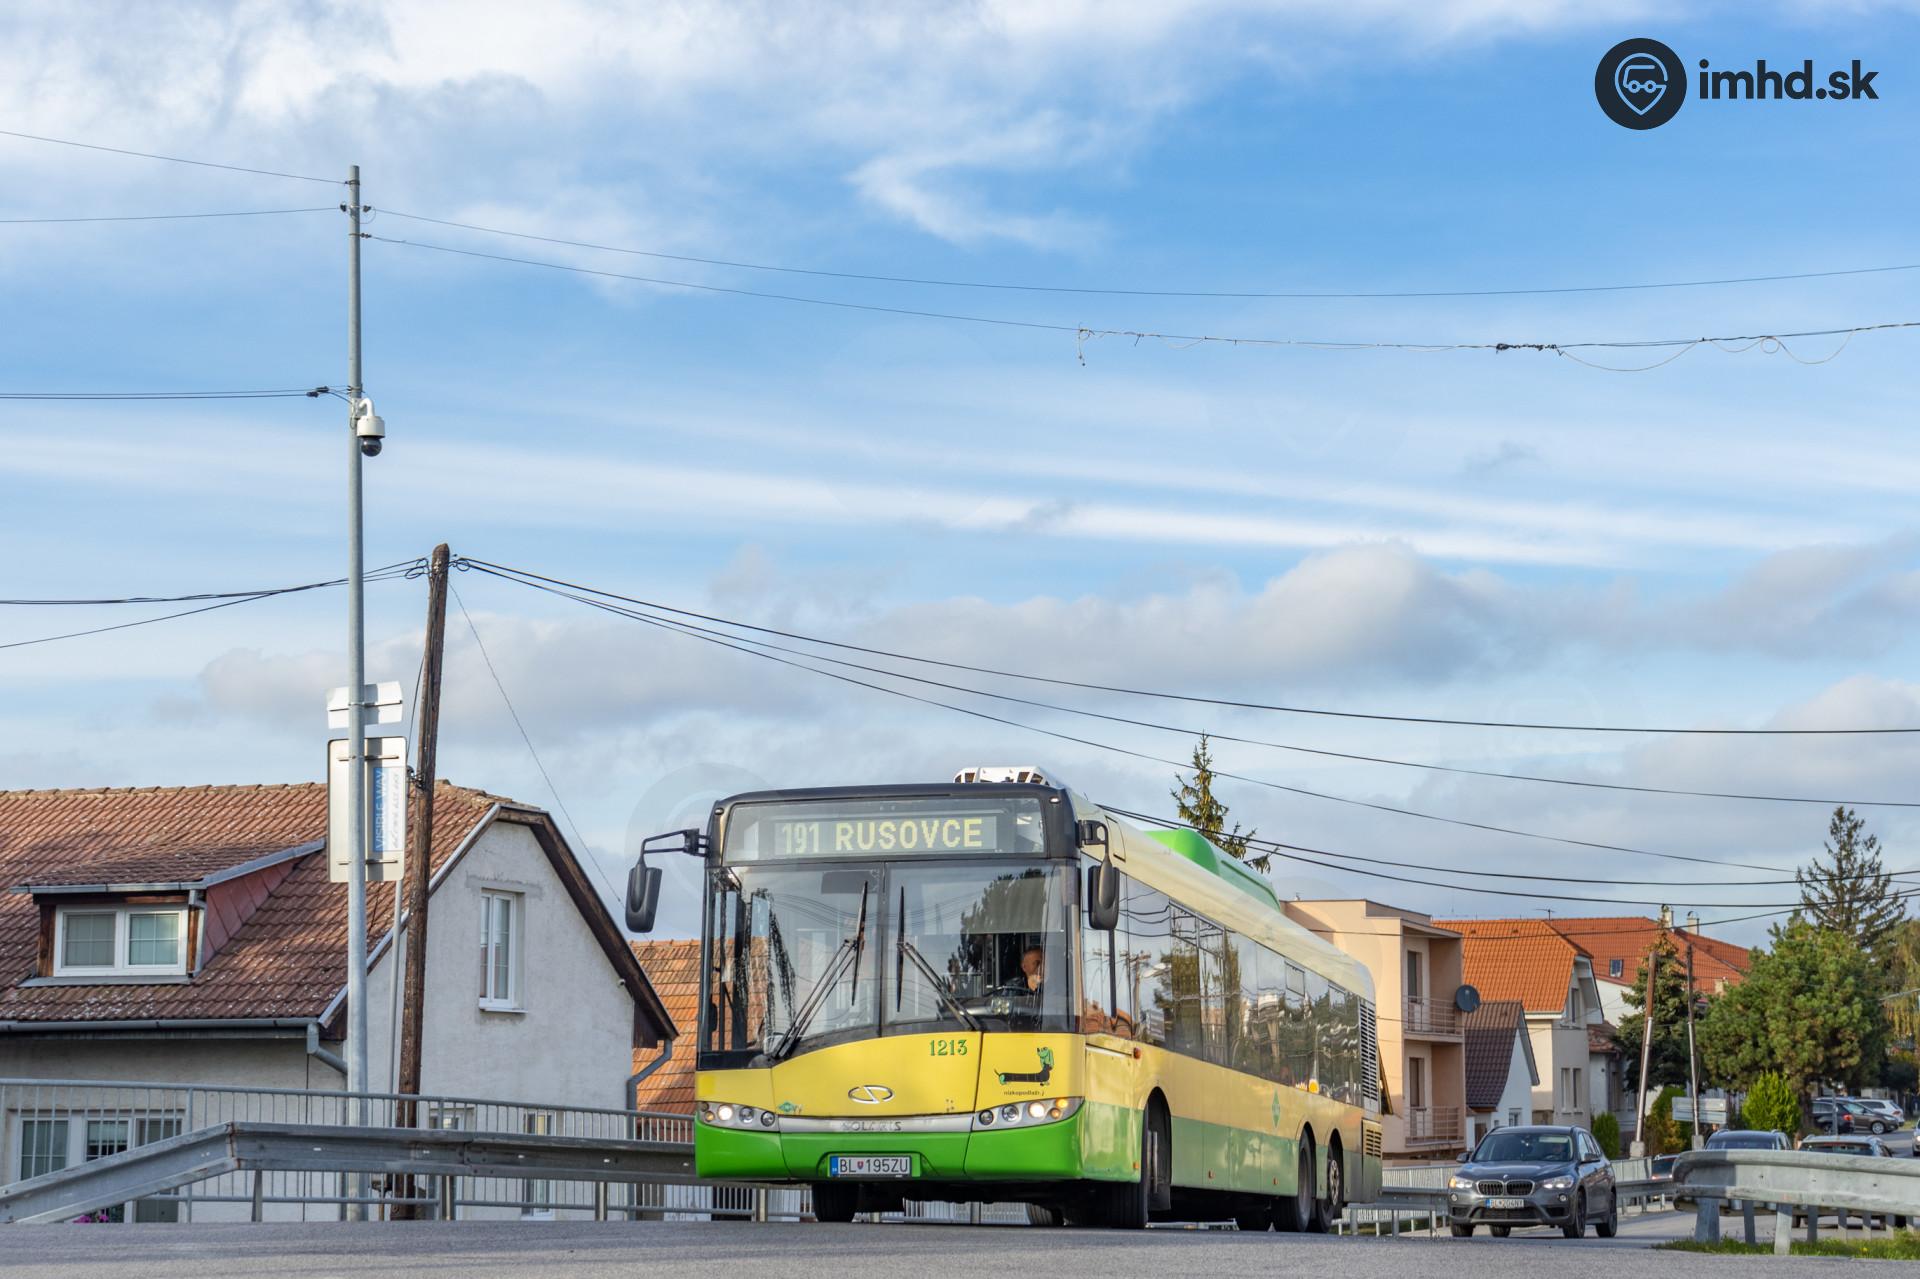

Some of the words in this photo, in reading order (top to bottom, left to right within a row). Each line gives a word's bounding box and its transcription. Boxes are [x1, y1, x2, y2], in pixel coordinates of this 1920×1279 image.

[782, 823, 820, 855] 191
[835, 818, 983, 851] RUSOVCE
[930, 1039, 968, 1056] 1213
